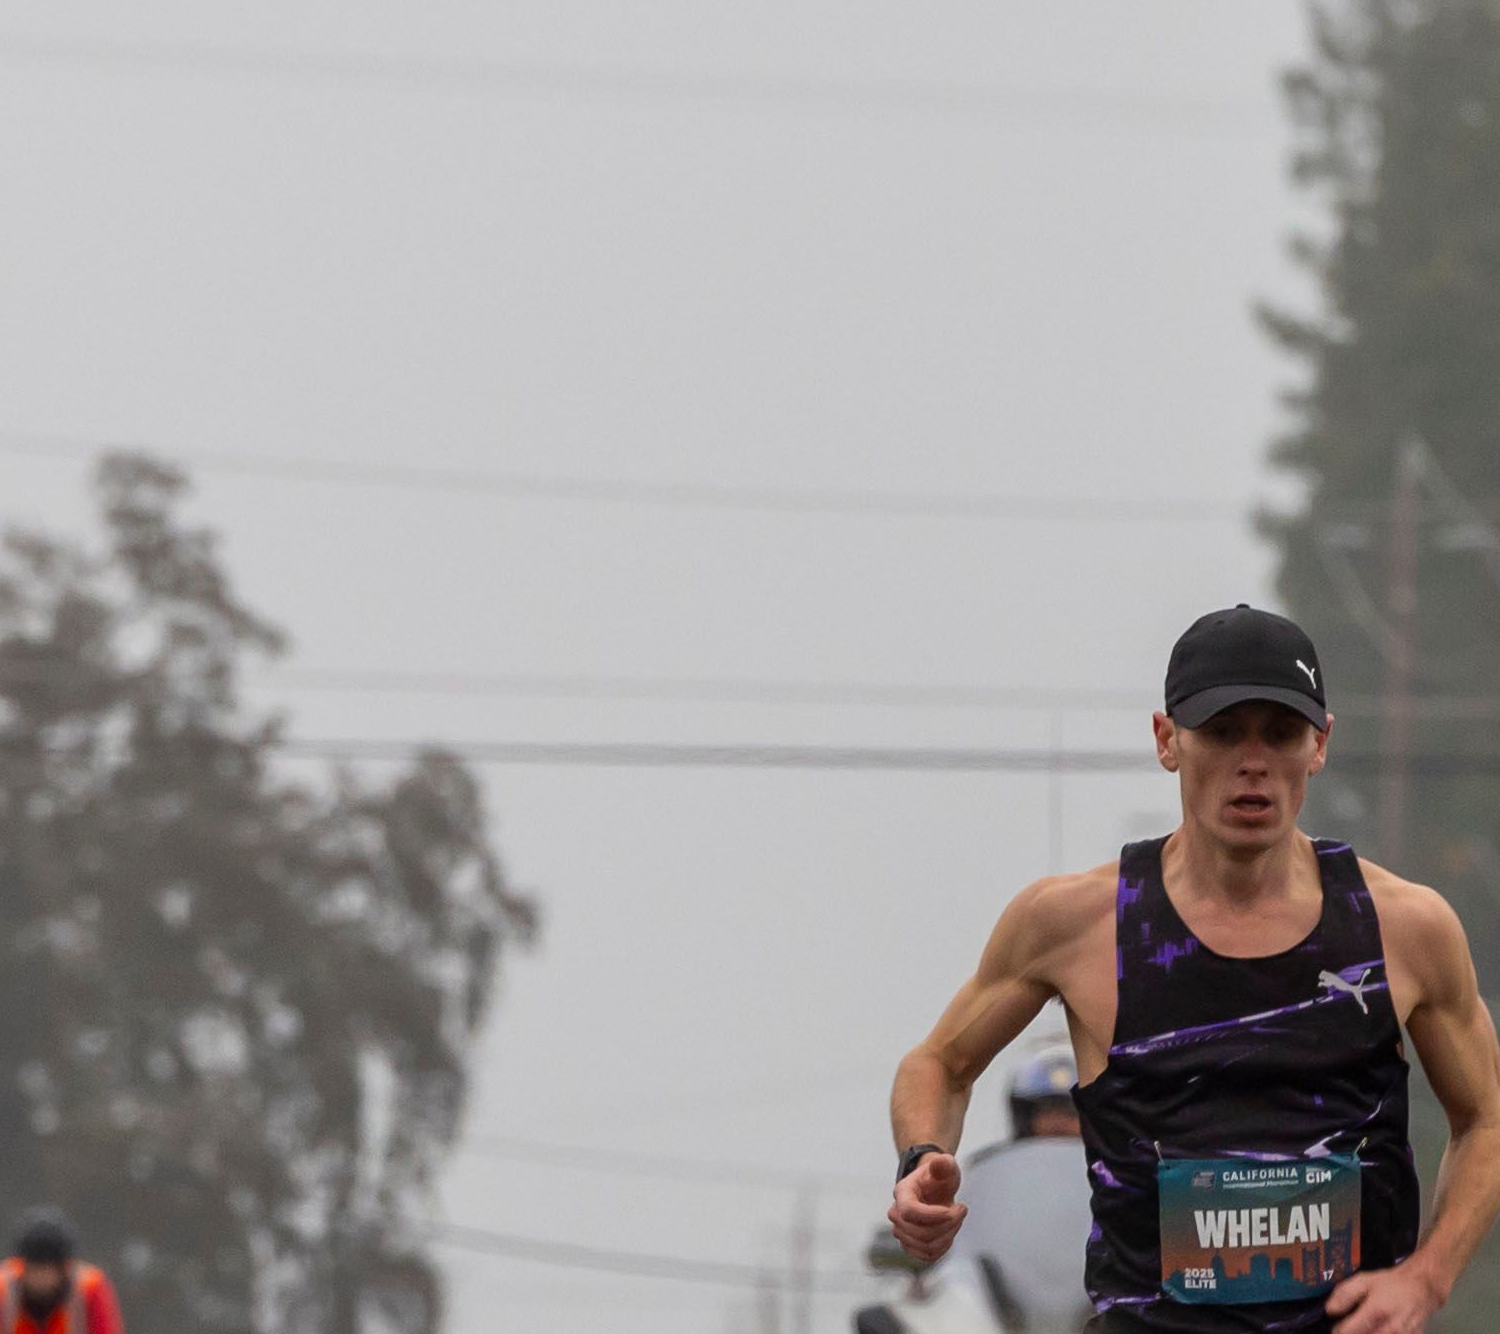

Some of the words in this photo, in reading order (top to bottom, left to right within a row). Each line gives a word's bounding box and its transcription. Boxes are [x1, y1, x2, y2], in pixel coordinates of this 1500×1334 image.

[1222, 1167, 1298, 1182] CALIFORNIA
[1305, 1170, 1332, 1184] CIM
[1193, 1202, 1331, 1249] WHELAN
[1184, 1268, 1215, 1279] 2025
[1323, 1269, 1334, 1281] 17
[1184, 1278, 1217, 1290] ELITE
